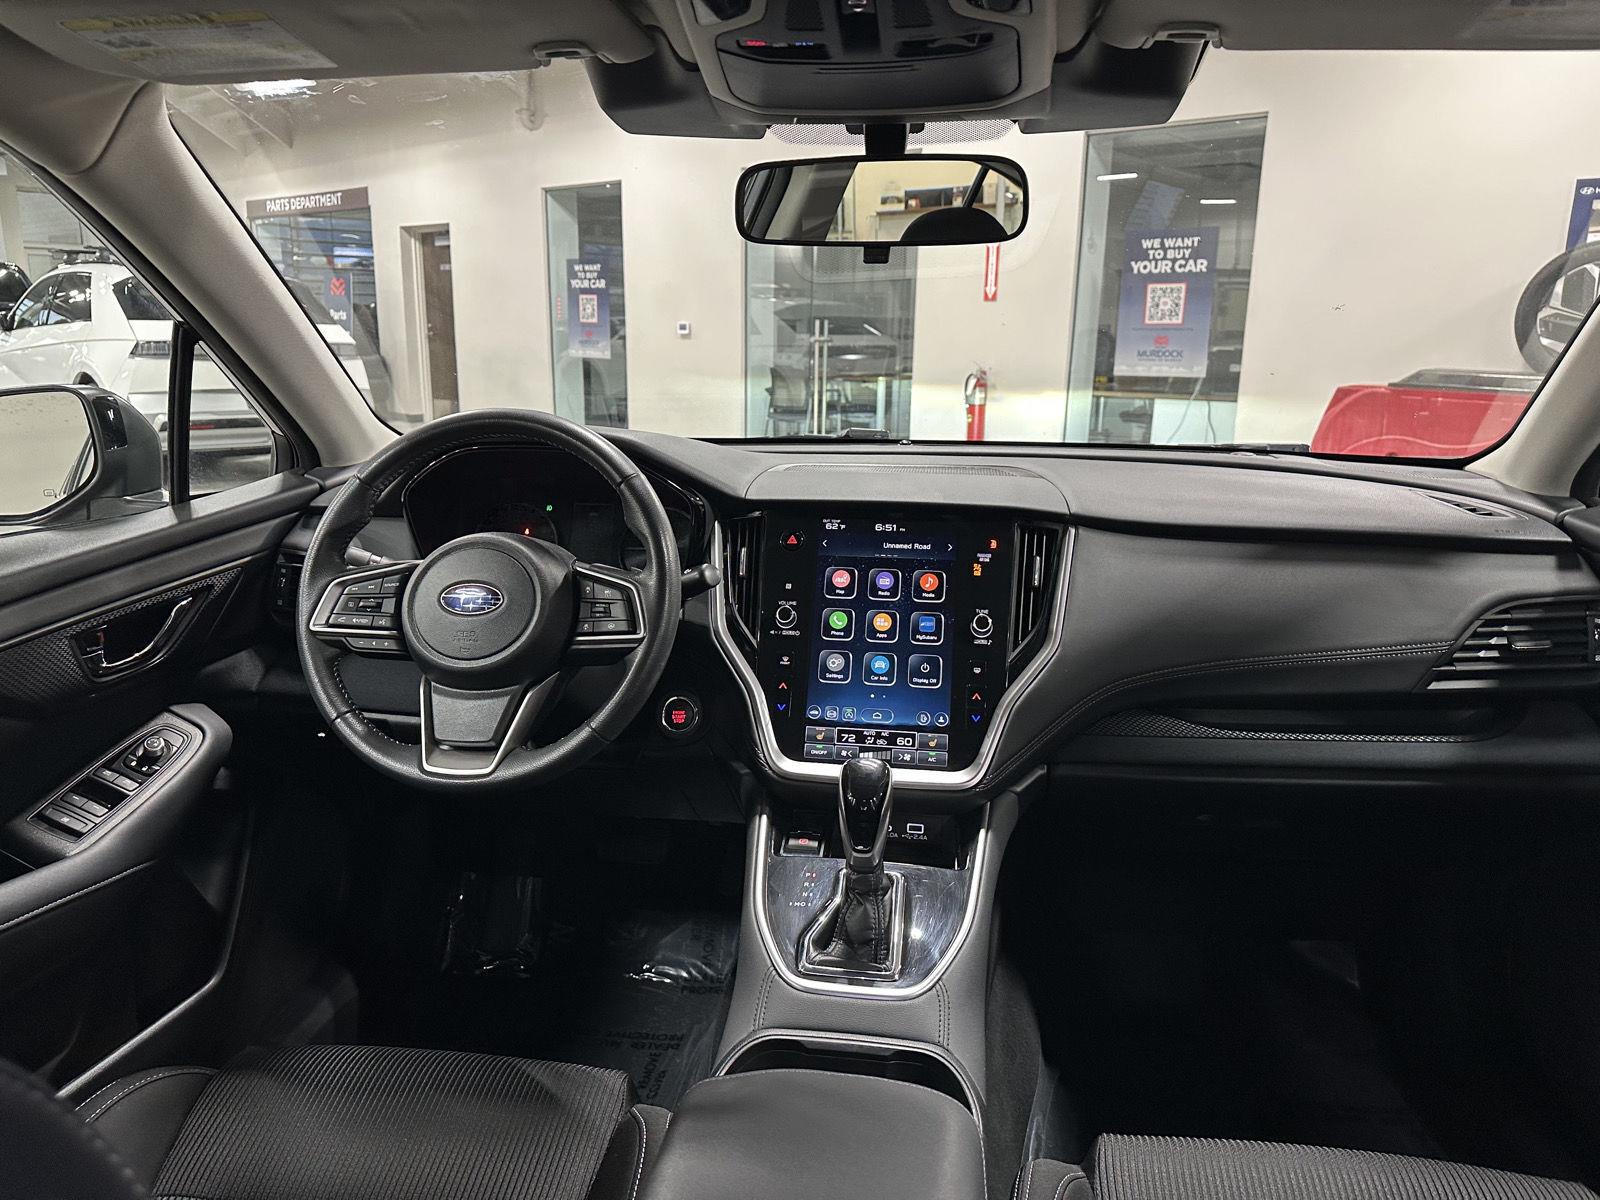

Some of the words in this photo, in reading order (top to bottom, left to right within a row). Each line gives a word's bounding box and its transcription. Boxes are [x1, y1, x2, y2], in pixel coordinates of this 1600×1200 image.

[266, 198, 290, 212] PARTS
[290, 192, 343, 211] DEPARTMENT
[1141, 238, 1162, 249] WE
[1163, 236, 1200, 248] WANT
[1147, 249, 1165, 260] TO
[1166, 248, 1192, 259] BUY
[573, 264, 584, 272] WE
[584, 264, 602, 272] WANT
[1130, 260, 1173, 275] YOUR
[1174, 259, 1208, 273] CAR
[570, 279, 589, 289] YOUR
[589, 279, 606, 289] CAR
[1136, 349, 1183, 358] MURDOCK
[875, 523, 897, 532] 6:51
[883, 542, 912, 550] Unnamed
[841, 734, 856, 742] 72
[896, 737, 913, 746] 60
